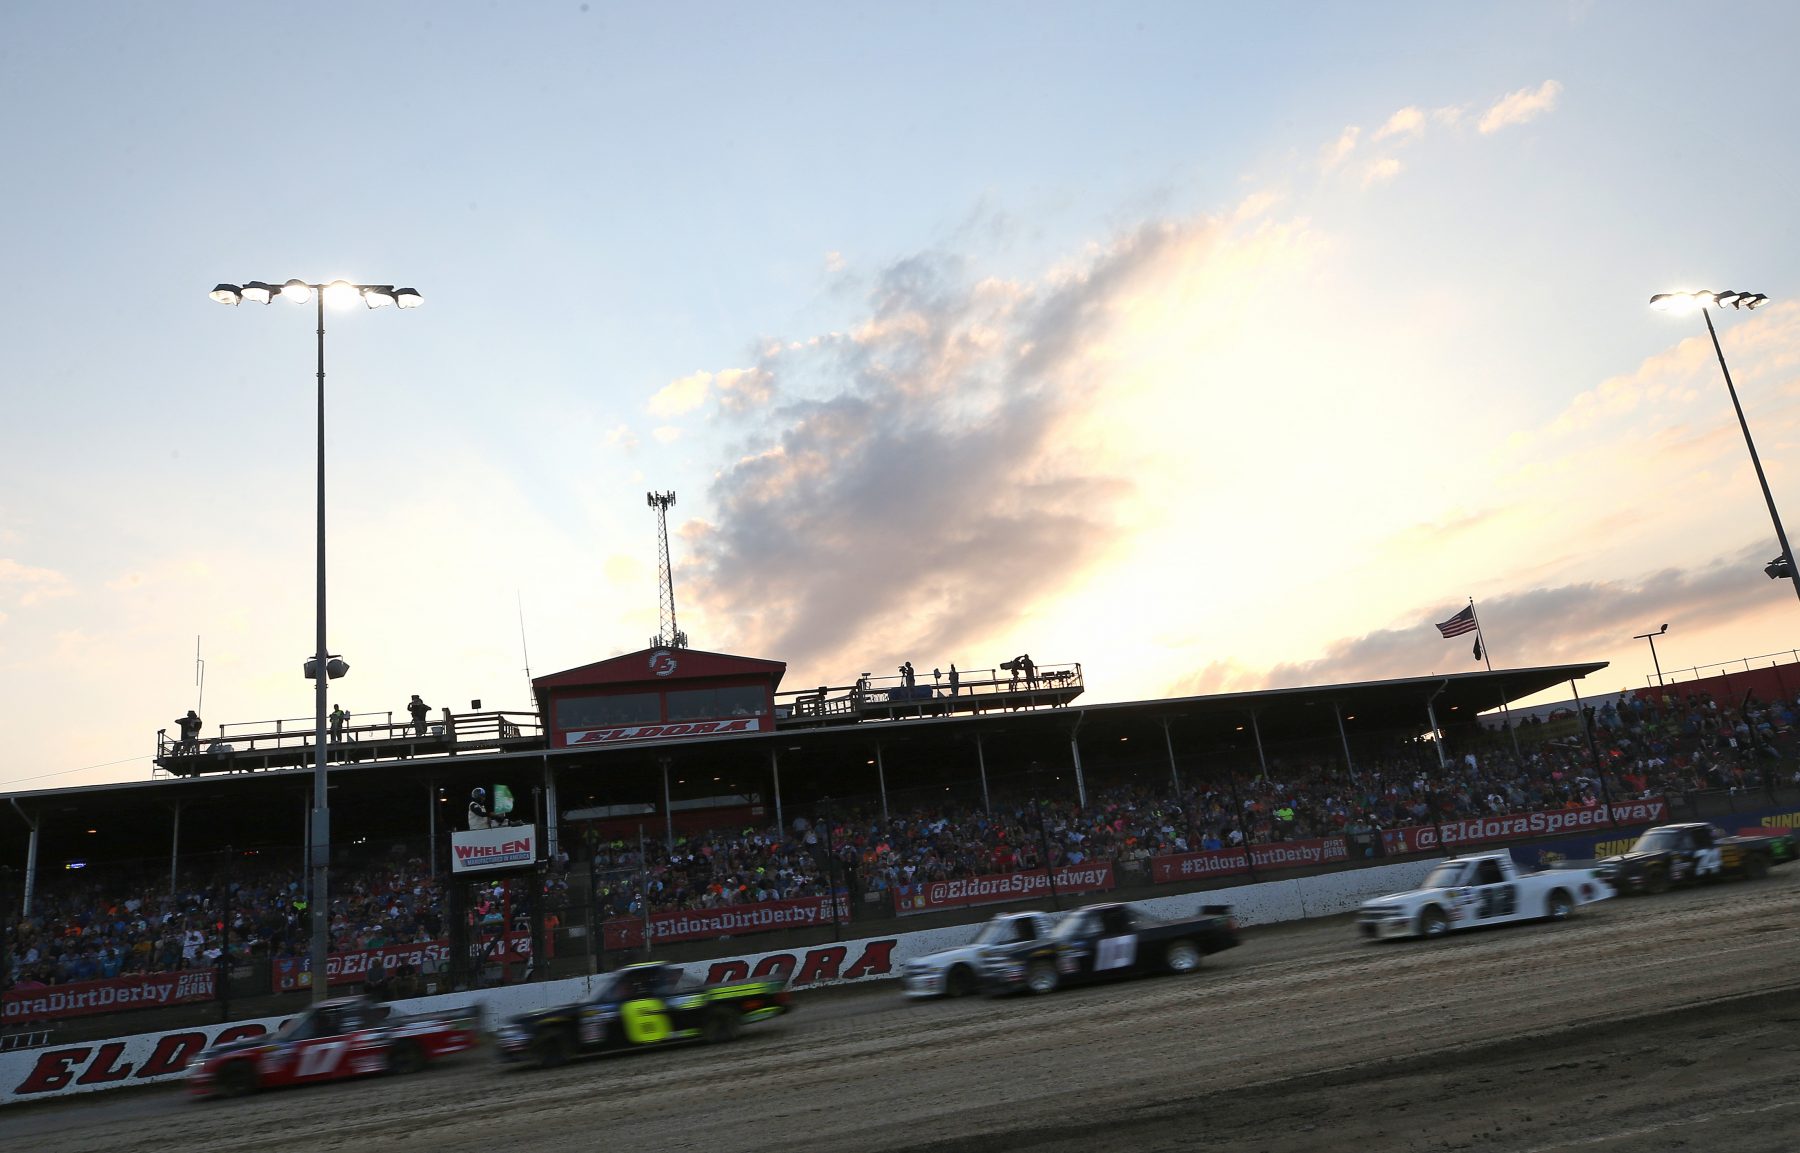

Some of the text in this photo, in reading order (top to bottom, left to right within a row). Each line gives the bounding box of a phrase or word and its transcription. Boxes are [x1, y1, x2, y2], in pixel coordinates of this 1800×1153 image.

[575, 720, 750, 743] ELDORA
[1415, 802, 1664, 850] @EldoraSpeedway
[454, 837, 530, 859] WHELEN
[1181, 846, 1321, 873] #EldoraDirtDerby
[931, 868, 1108, 903] @EldoraSpeedway
[641, 906, 817, 939] #EldoraDirtDerby
[0, 981, 173, 1017] oraDirtDerby
[621, 998, 673, 1044] 6
